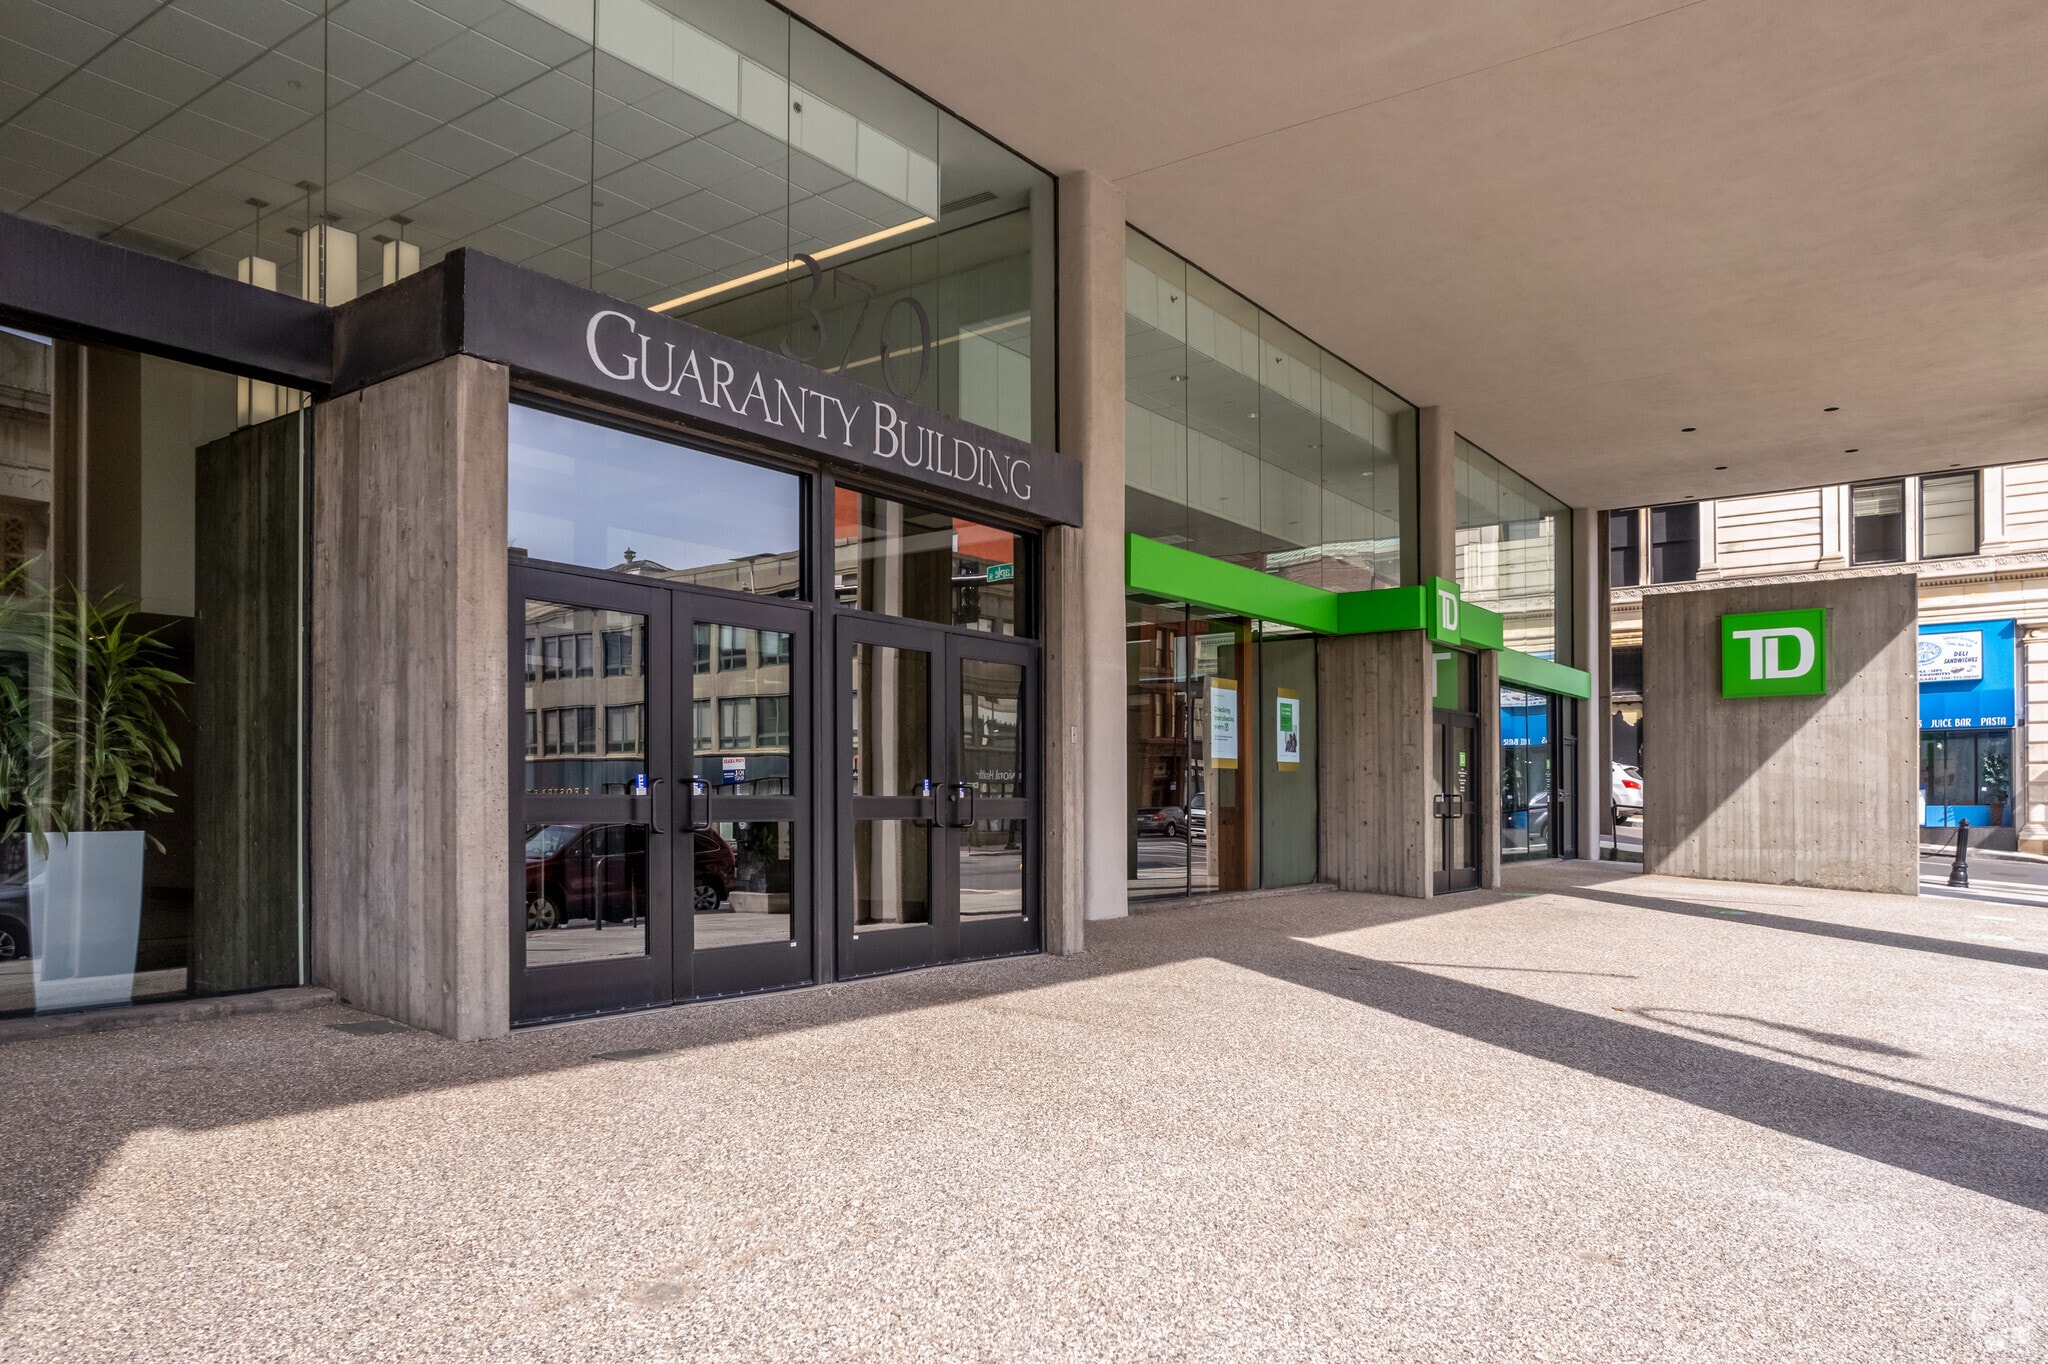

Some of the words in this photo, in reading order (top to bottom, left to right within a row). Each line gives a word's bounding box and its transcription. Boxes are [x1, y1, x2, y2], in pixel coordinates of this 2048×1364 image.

[780, 253, 931, 401] 370
[586, 310, 861, 448] GUARANTY
[872, 400, 1032, 500] BUILDING
[1438, 589, 1458, 632] TD
[1732, 626, 1816, 681] TD
[1214, 706, 1231, 714] Checking
[1931, 718, 1953, 728] JUICE
[1954, 717, 1972, 727] BAR
[1980, 716, 2007, 726] PASTA
